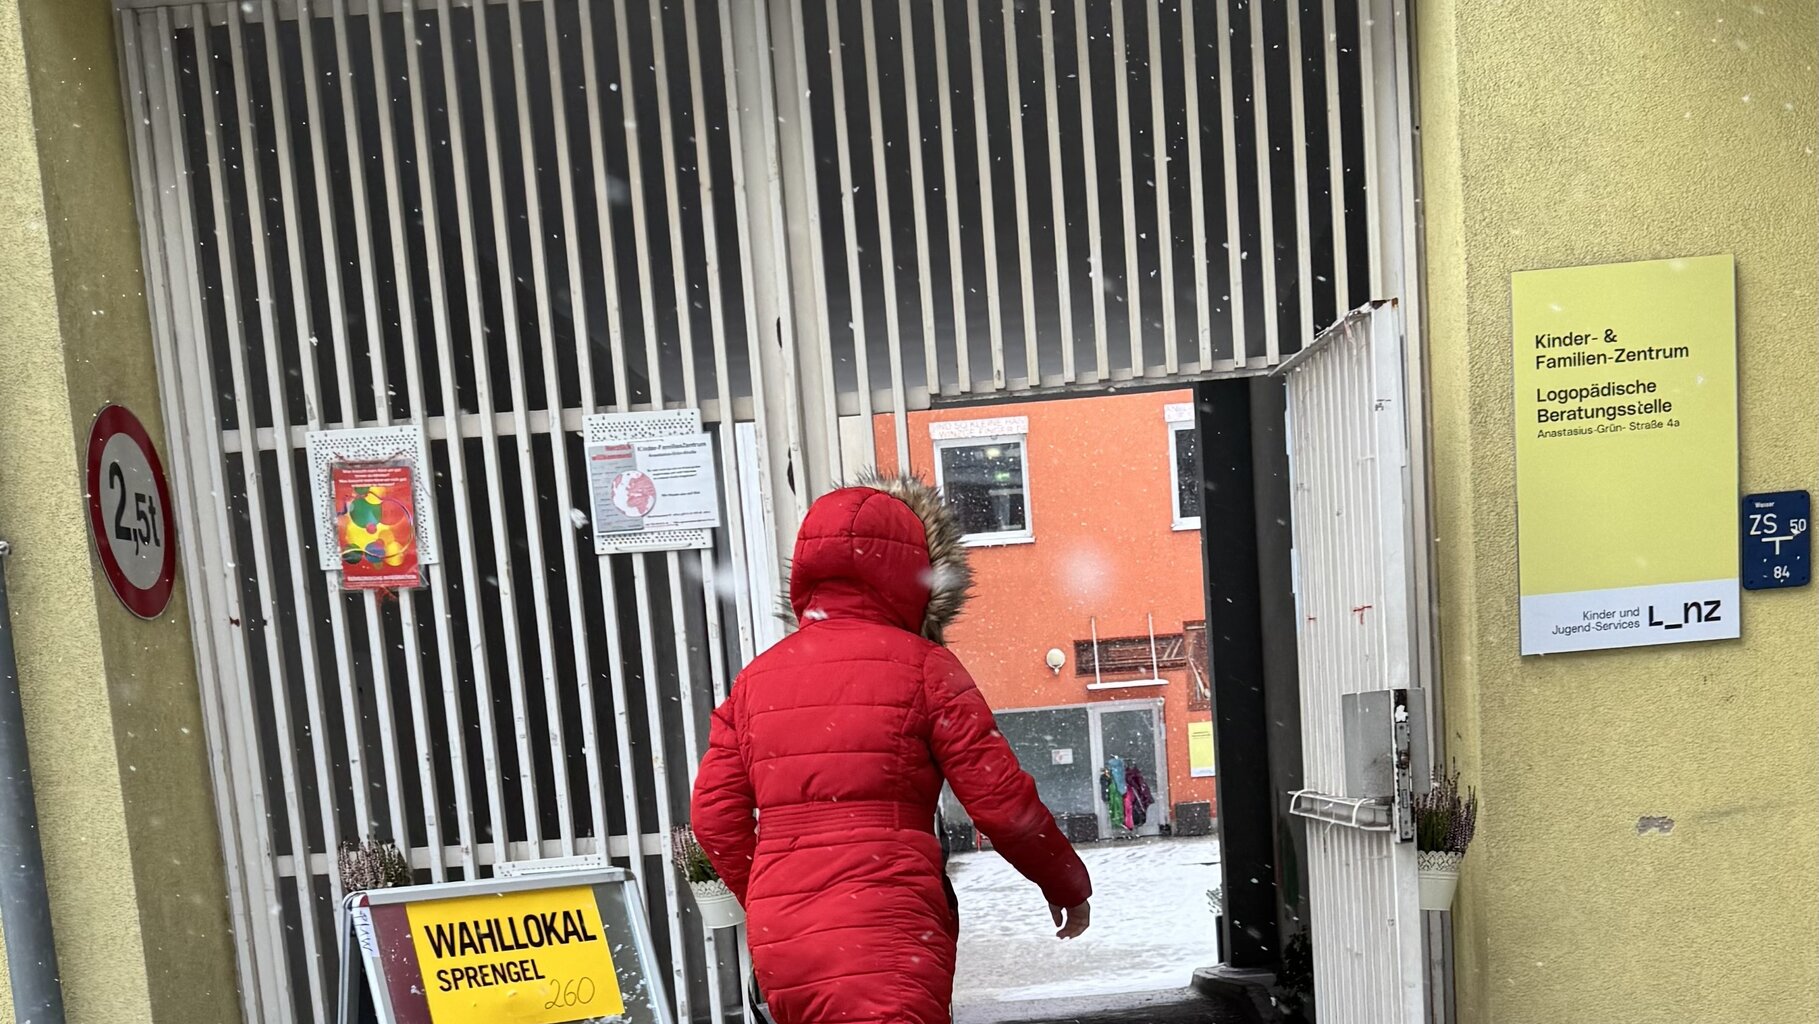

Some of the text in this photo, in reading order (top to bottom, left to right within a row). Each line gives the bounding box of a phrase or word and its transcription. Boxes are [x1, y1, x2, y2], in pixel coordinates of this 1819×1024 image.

[1535, 328, 1618, 349] Kinder- &
[1536, 346, 1689, 370] Familien-Zentrum
[1536, 380, 1657, 404] Logopädische
[1537, 399, 1672, 423] Beratungsstelle
[1537, 418, 1681, 439] Anastasius-Grün- Straße 4a
[108, 461, 161, 556] 2,5t
[1749, 513, 1807, 536] ZS 50
[1773, 565, 1790, 579] 84
[1583, 607, 1640, 621] Kinder und
[1552, 619, 1640, 636] Jugend-Services
[424, 909, 598, 959] WAHLLOKAL
[436, 959, 545, 992] SPRENGEL
[544, 976, 596, 1010] 260
